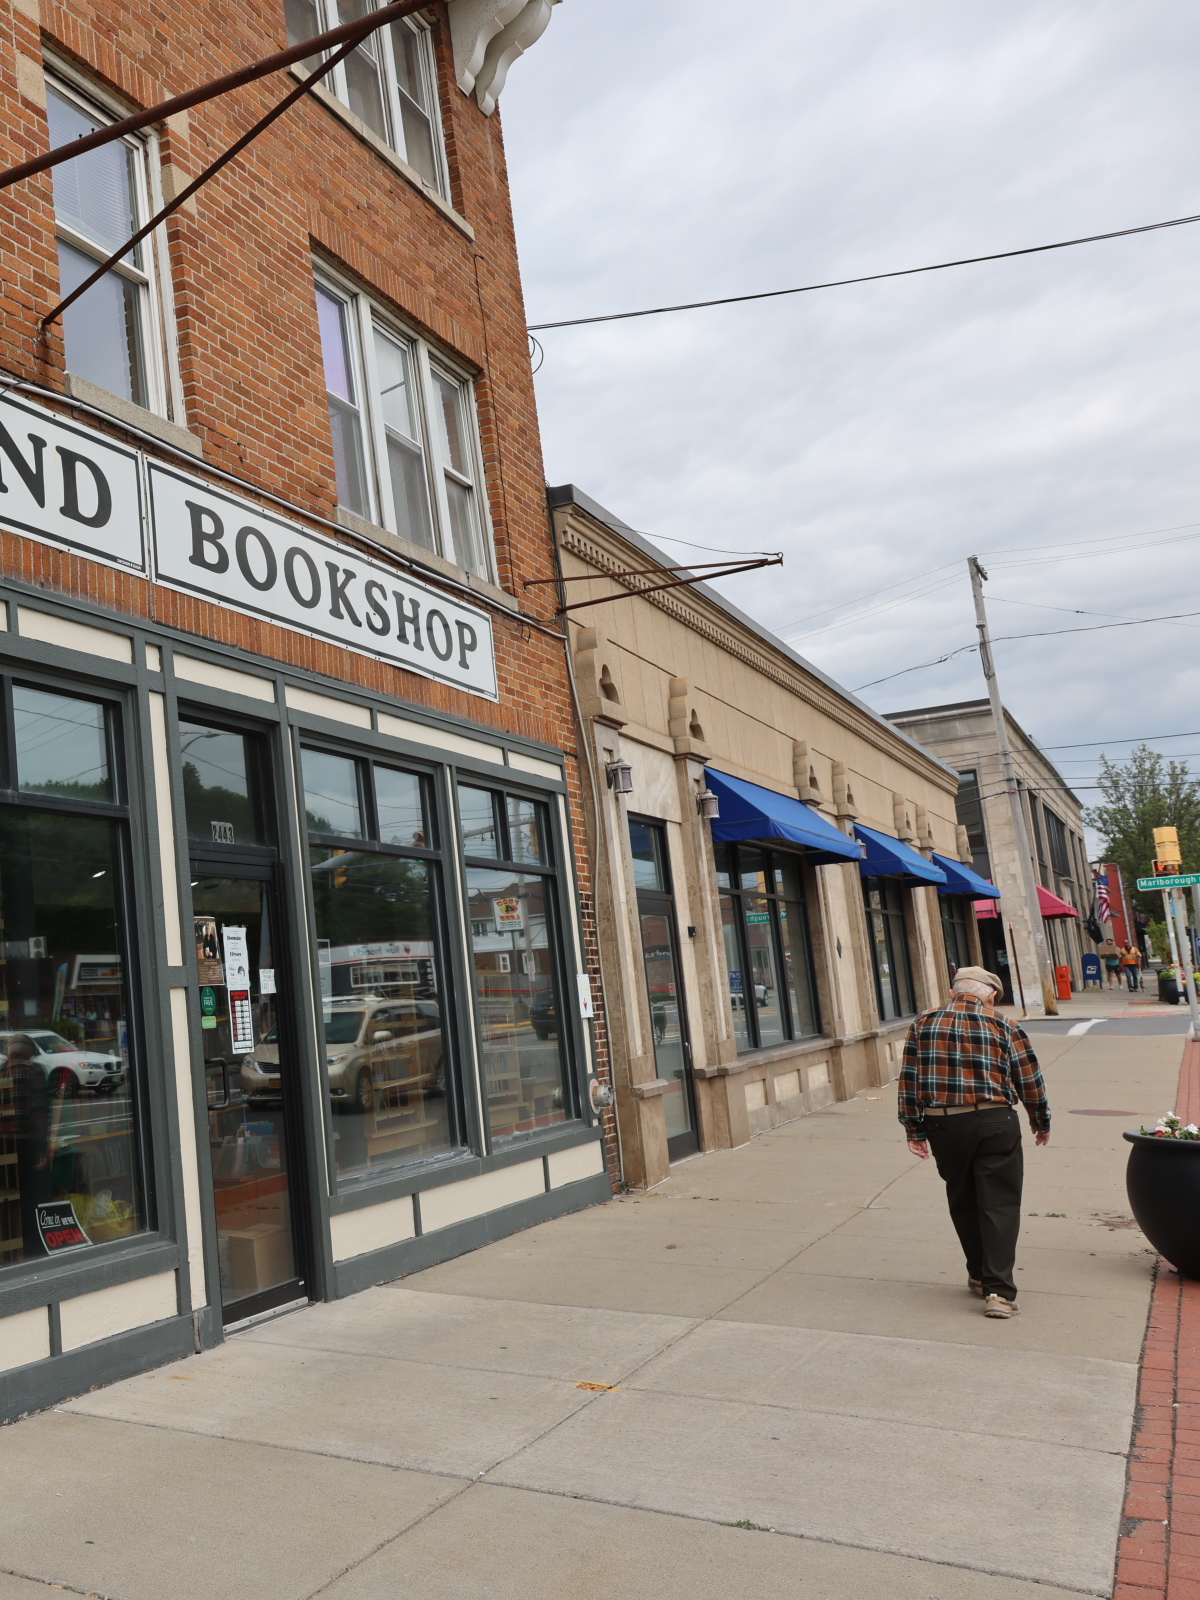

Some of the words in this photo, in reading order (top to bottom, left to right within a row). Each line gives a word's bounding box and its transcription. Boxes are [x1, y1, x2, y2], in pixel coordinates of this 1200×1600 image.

[184, 499, 478, 671] BOOKSHOP
[212, 824, 234, 843] 2443
[1140, 876, 1197, 886] Marlborough
[40, 1210, 54, 1226] Come
[45, 1228, 86, 1248] OPEN
